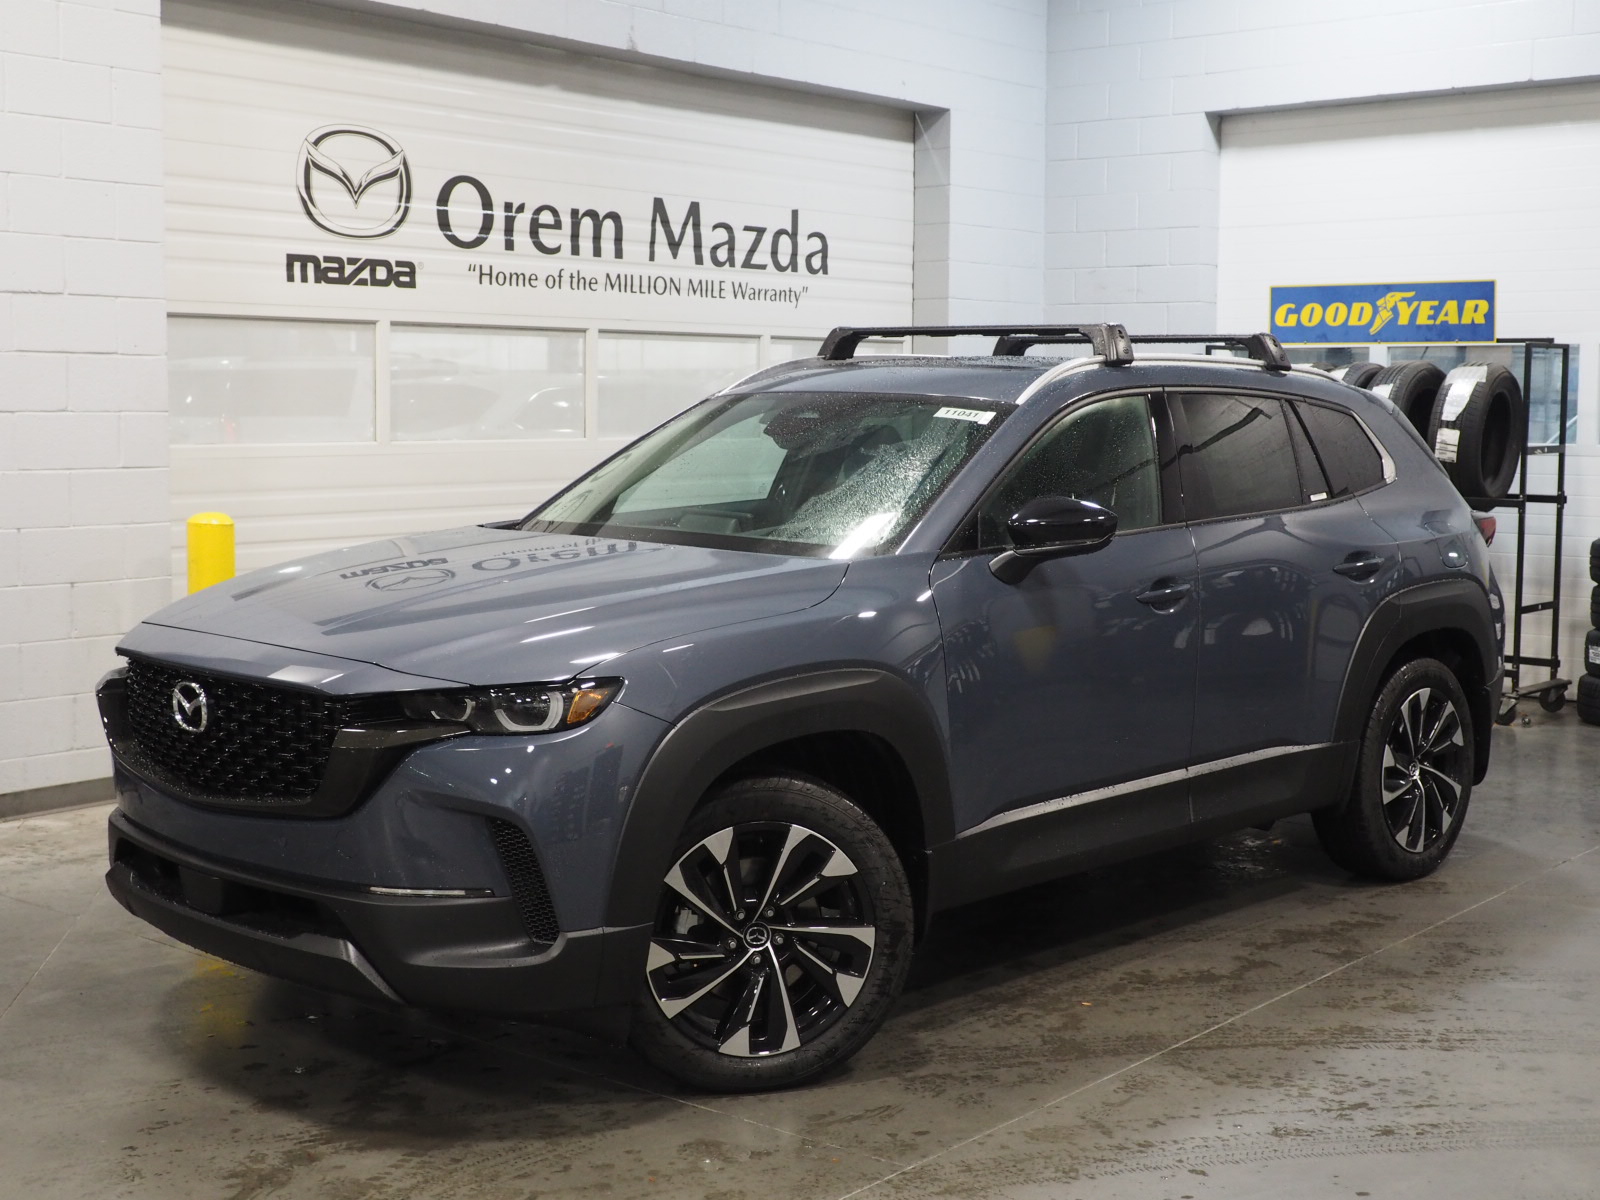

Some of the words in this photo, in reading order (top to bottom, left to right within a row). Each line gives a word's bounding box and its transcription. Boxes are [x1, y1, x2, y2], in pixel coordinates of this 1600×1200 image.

[436, 175, 624, 260] Orem
[649, 197, 829, 275] Mazda
[286, 253, 416, 289] mazda
[545, 268, 565, 290] of
[569, 270, 598, 292] the
[604, 272, 681, 297] MILLION
[687, 278, 726, 299] MILE
[944, 409, 979, 418] 11041
